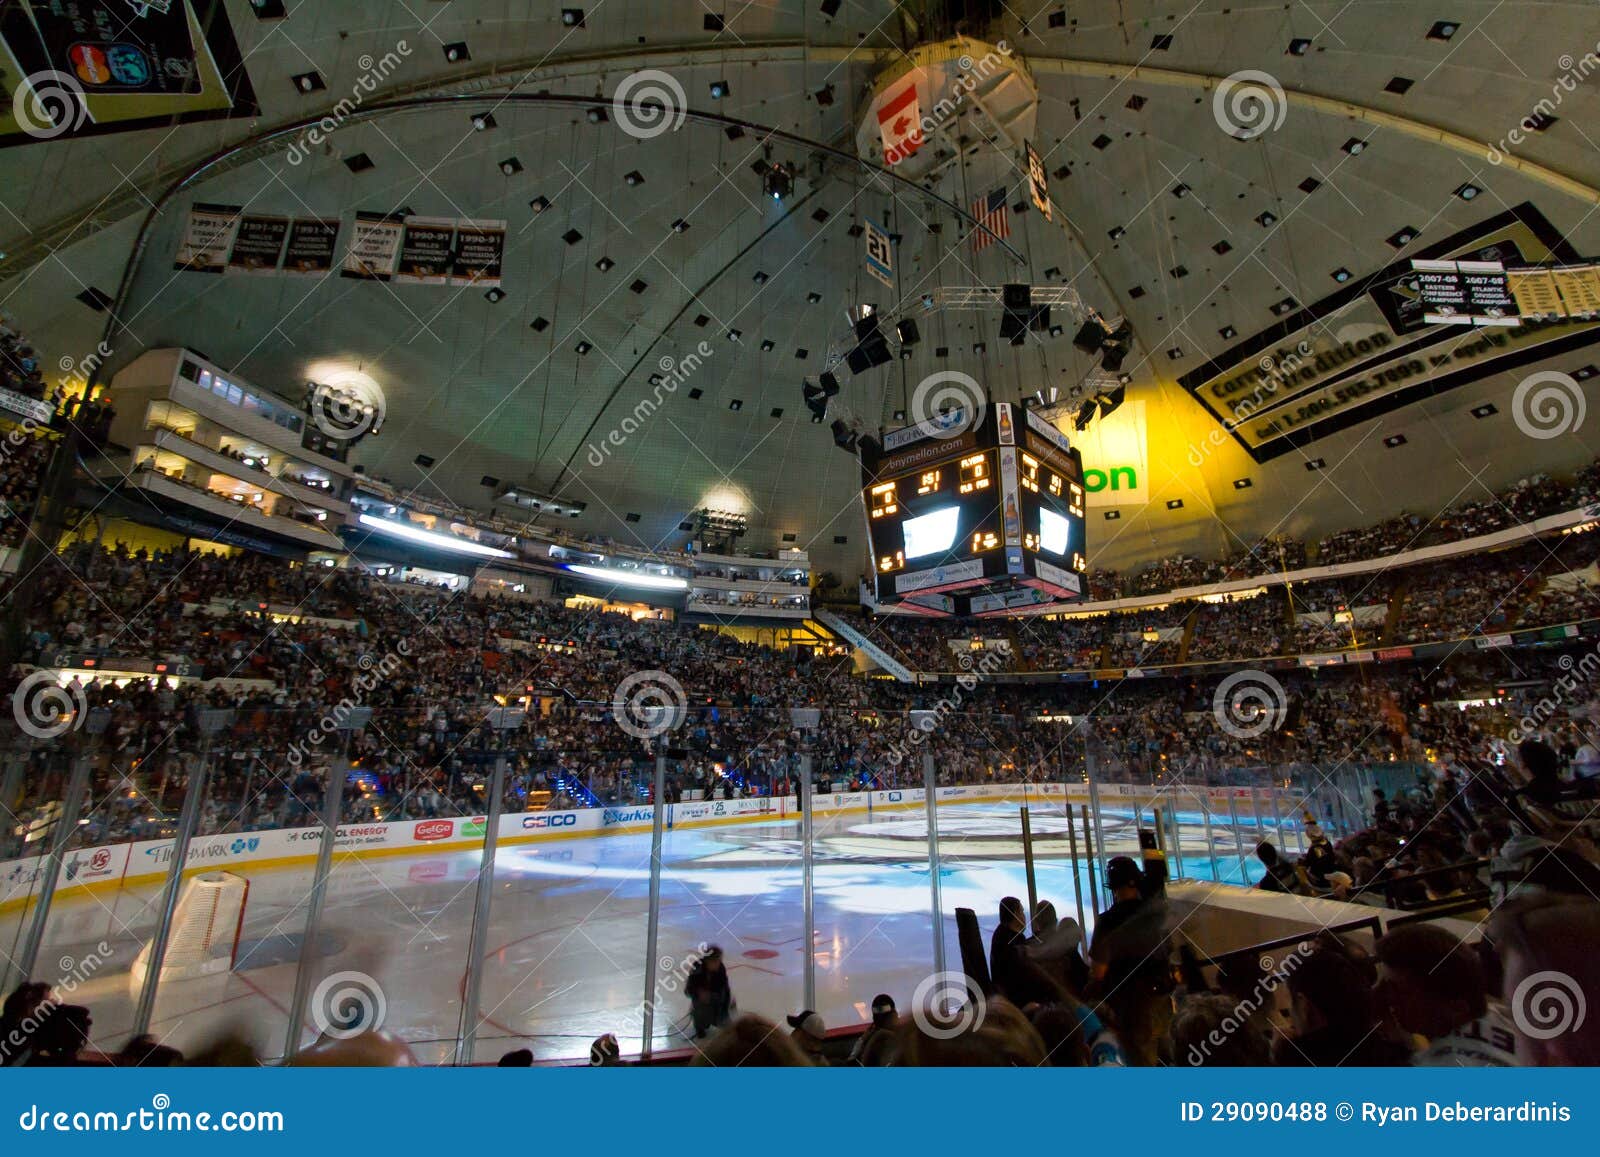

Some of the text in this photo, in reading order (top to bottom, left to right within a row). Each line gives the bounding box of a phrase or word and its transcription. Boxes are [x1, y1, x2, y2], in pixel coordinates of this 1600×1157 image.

[868, 233, 890, 267] 21
[1418, 274, 1459, 284] 2007-08
[1464, 276, 1505, 285] 2007-08
[889, 438, 964, 469] bnymellon.com
[416, 824, 452, 835] GetGo
[522, 813, 577, 830] GEICO
[301, 826, 389, 841] CONOL ENERGY
[153, 843, 228, 863] HIHMARK
